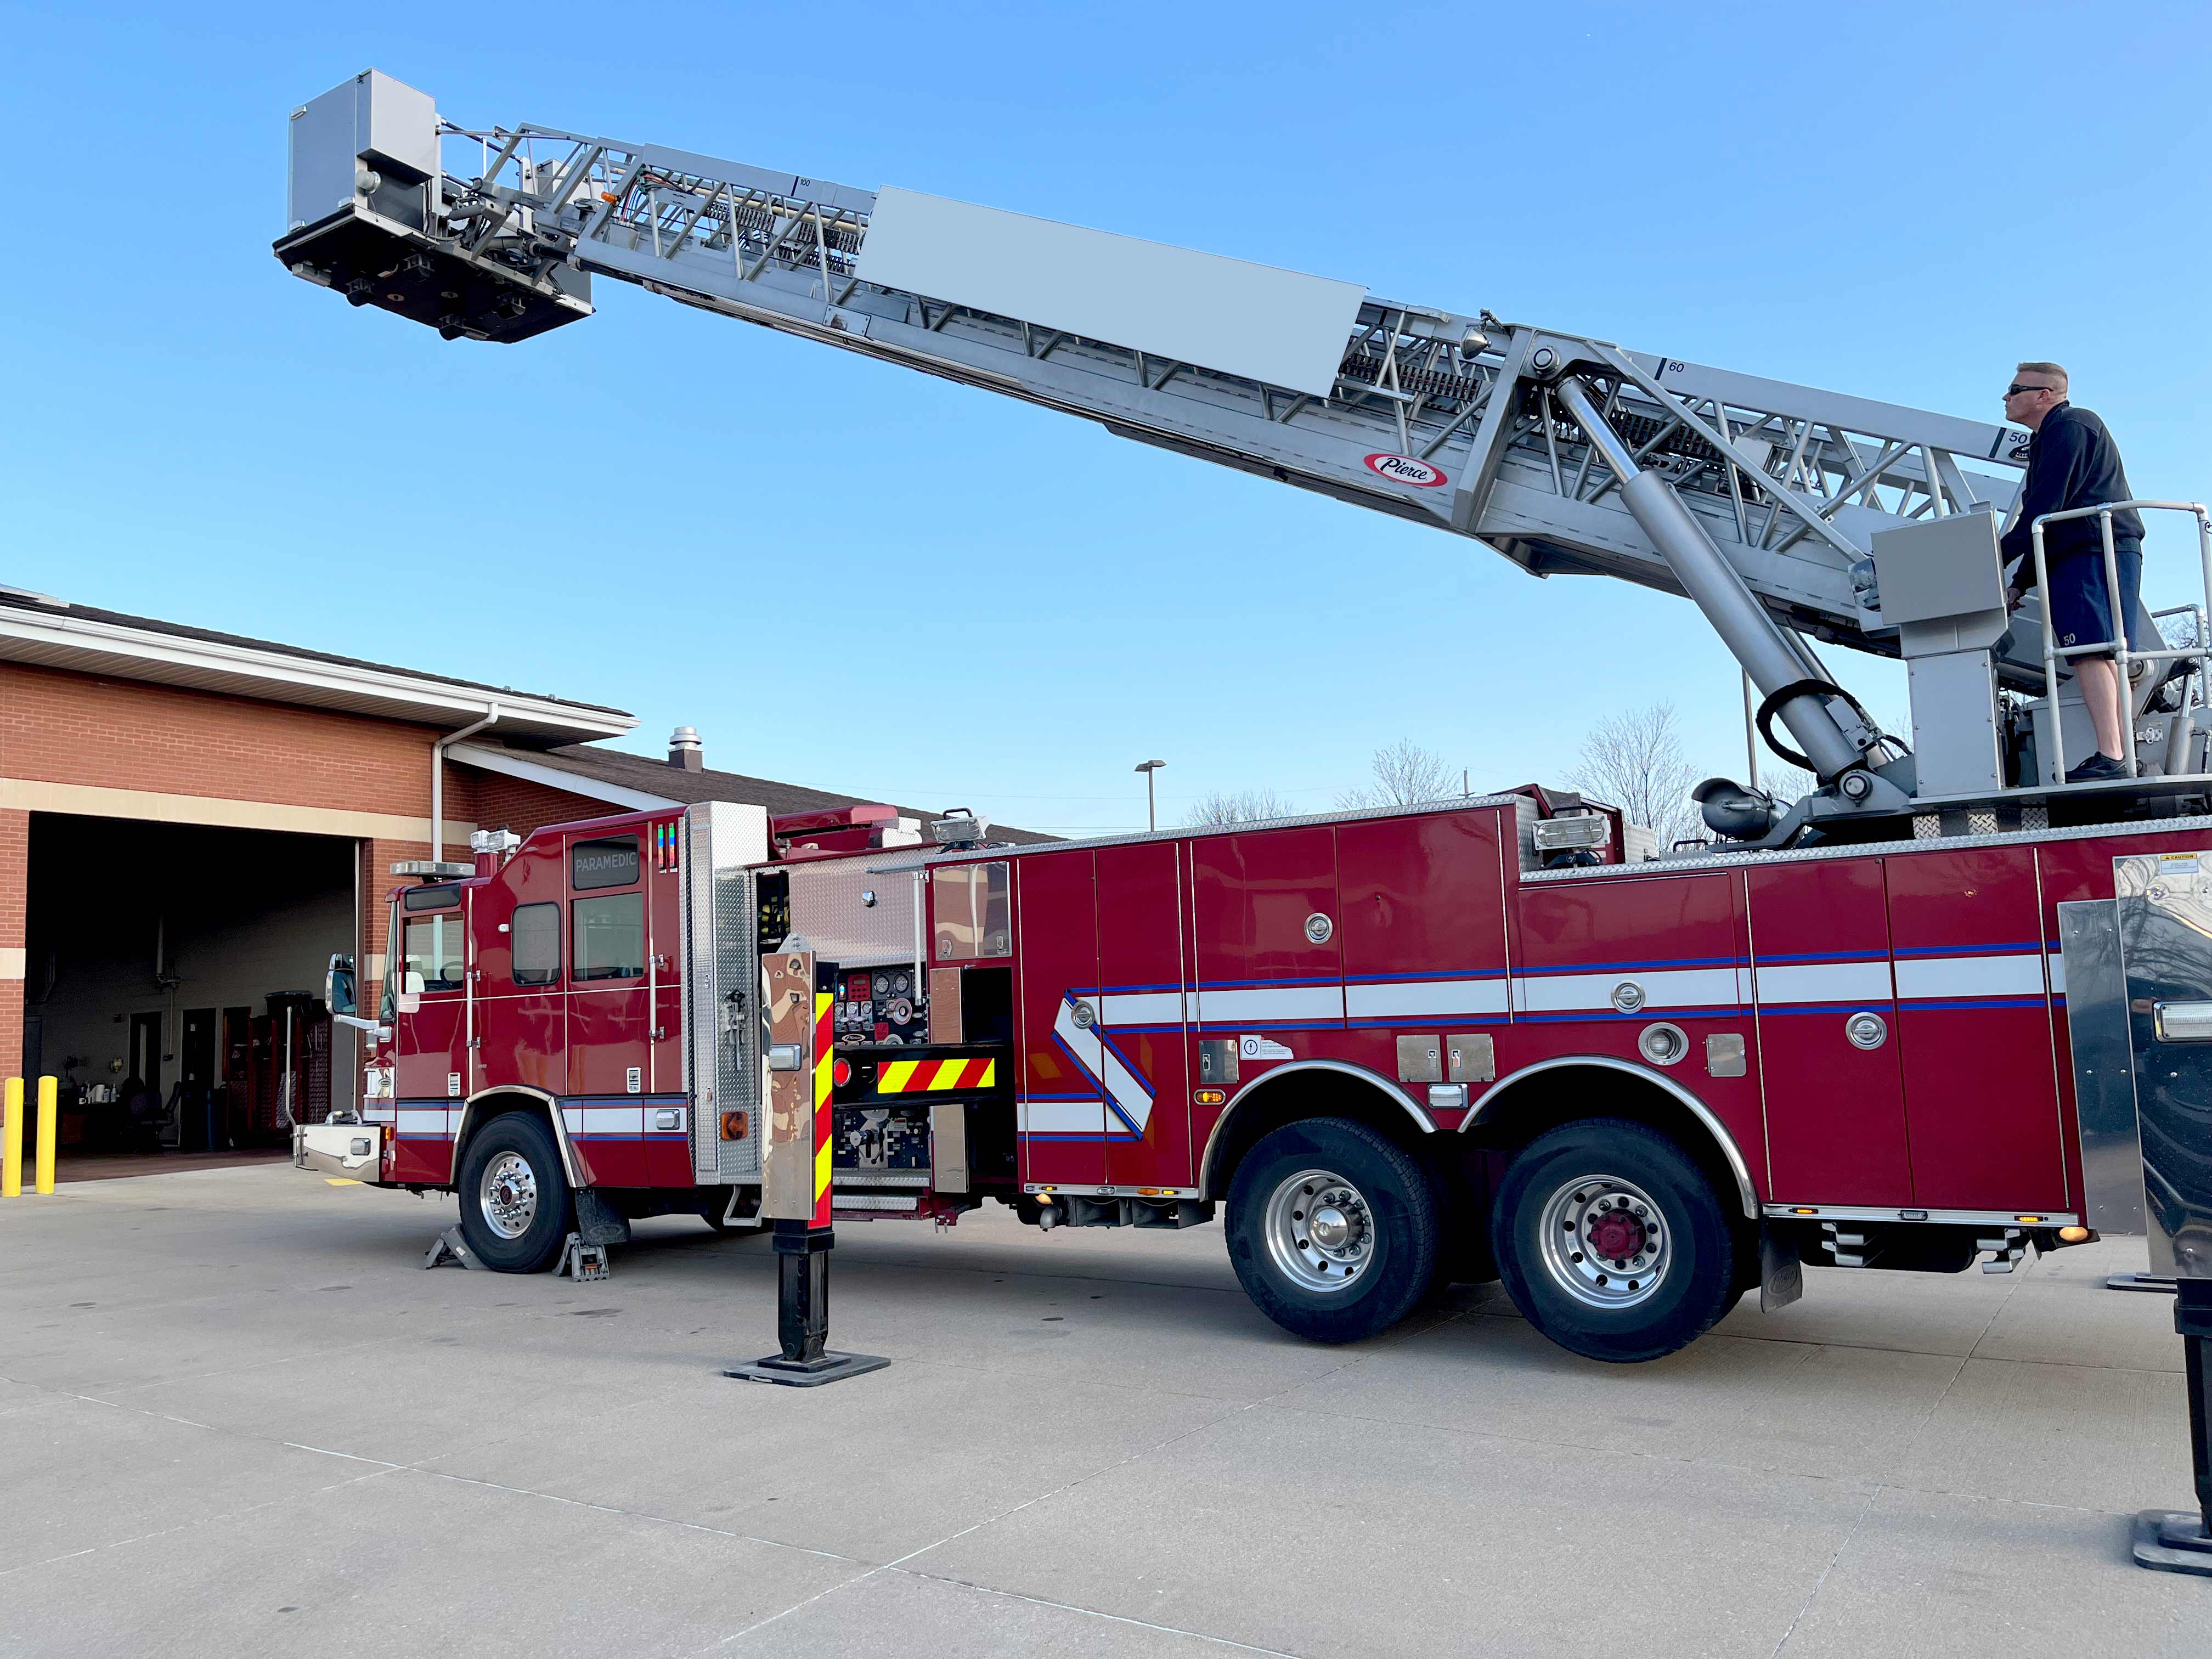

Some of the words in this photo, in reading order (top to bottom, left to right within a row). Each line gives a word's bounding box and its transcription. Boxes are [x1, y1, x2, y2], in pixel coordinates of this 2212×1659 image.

[1669, 362, 1684, 373] 60
[2009, 432, 2028, 444] 50
[1380, 458, 1427, 479] Pierce
[2063, 633, 2075, 646] 50
[576, 851, 636, 872] PARAMEDIC
